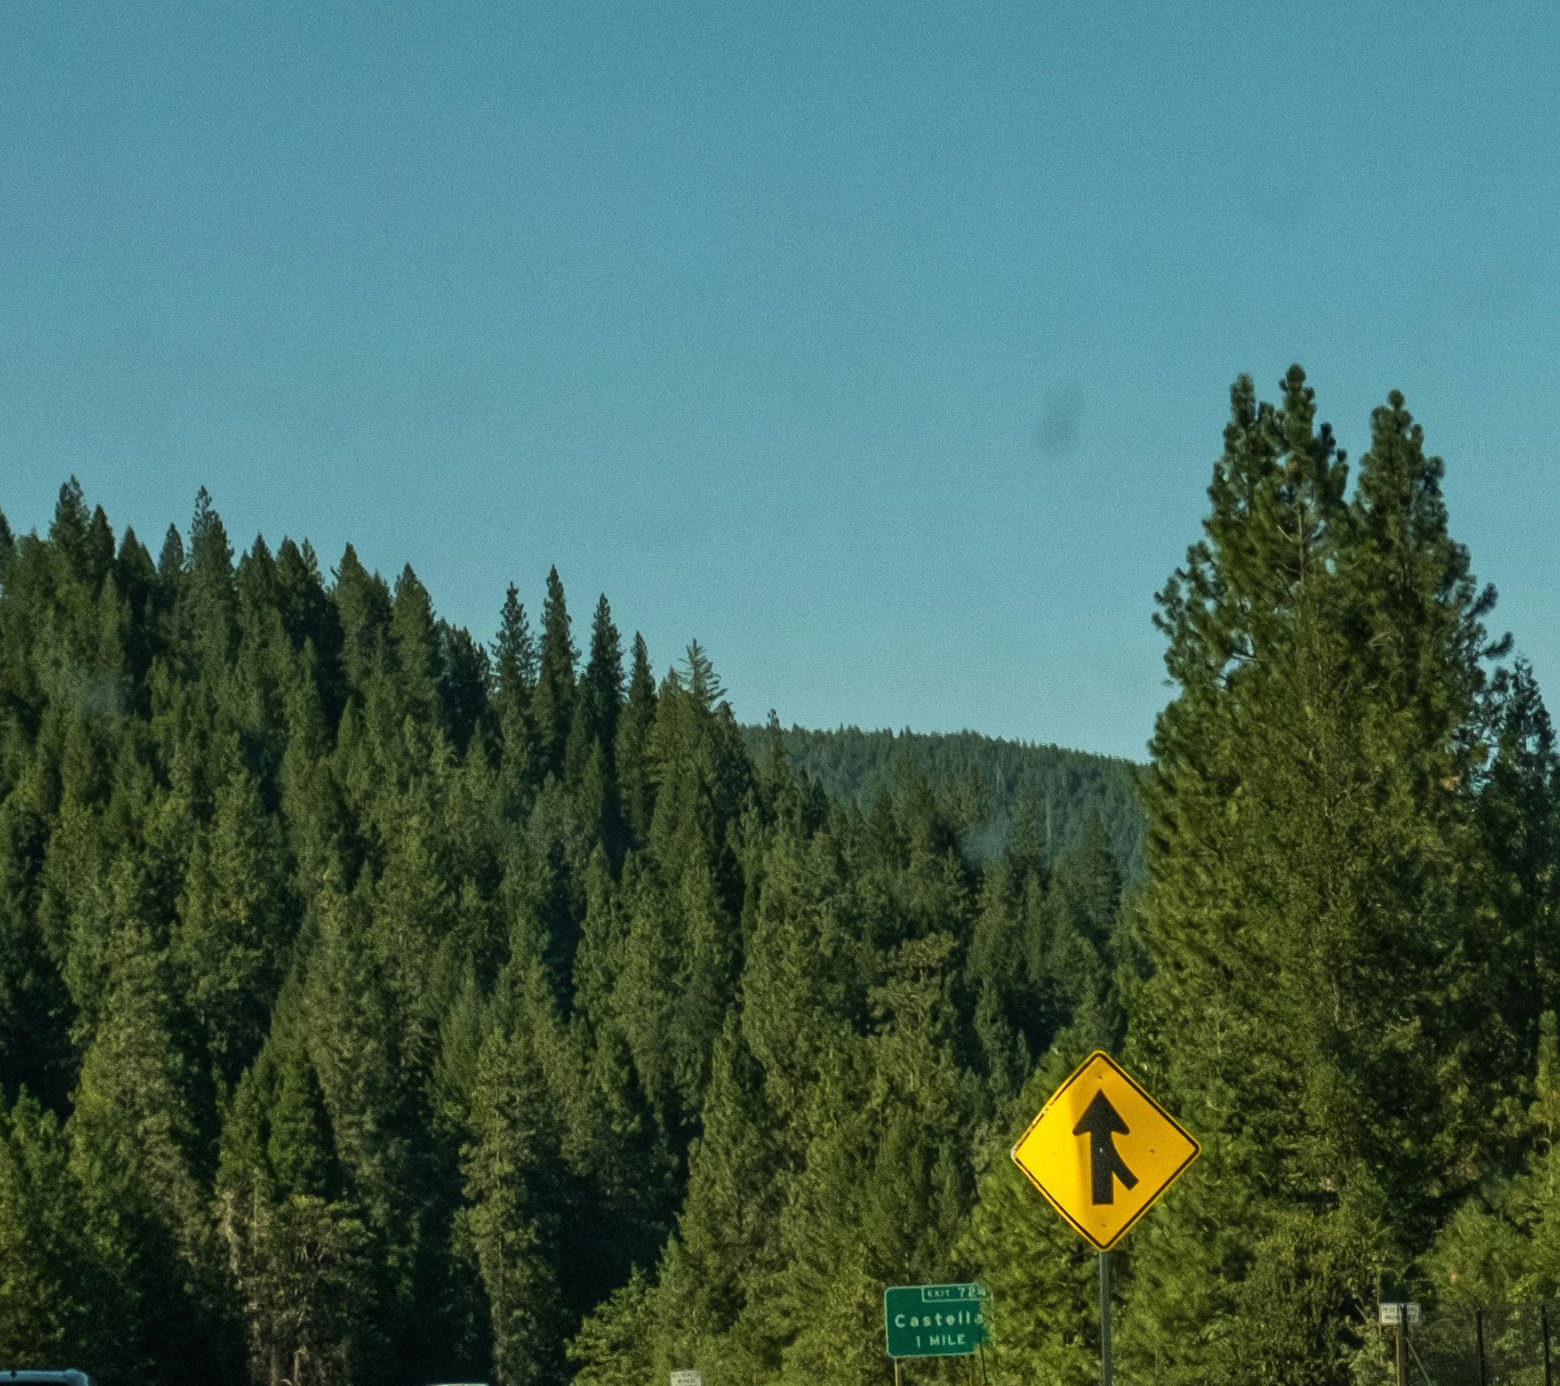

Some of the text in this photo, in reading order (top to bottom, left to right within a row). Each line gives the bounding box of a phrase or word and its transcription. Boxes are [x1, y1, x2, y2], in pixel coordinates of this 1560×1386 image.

[927, 1290, 950, 1298] EXIT
[915, 1334, 966, 1348] 1 MILE
